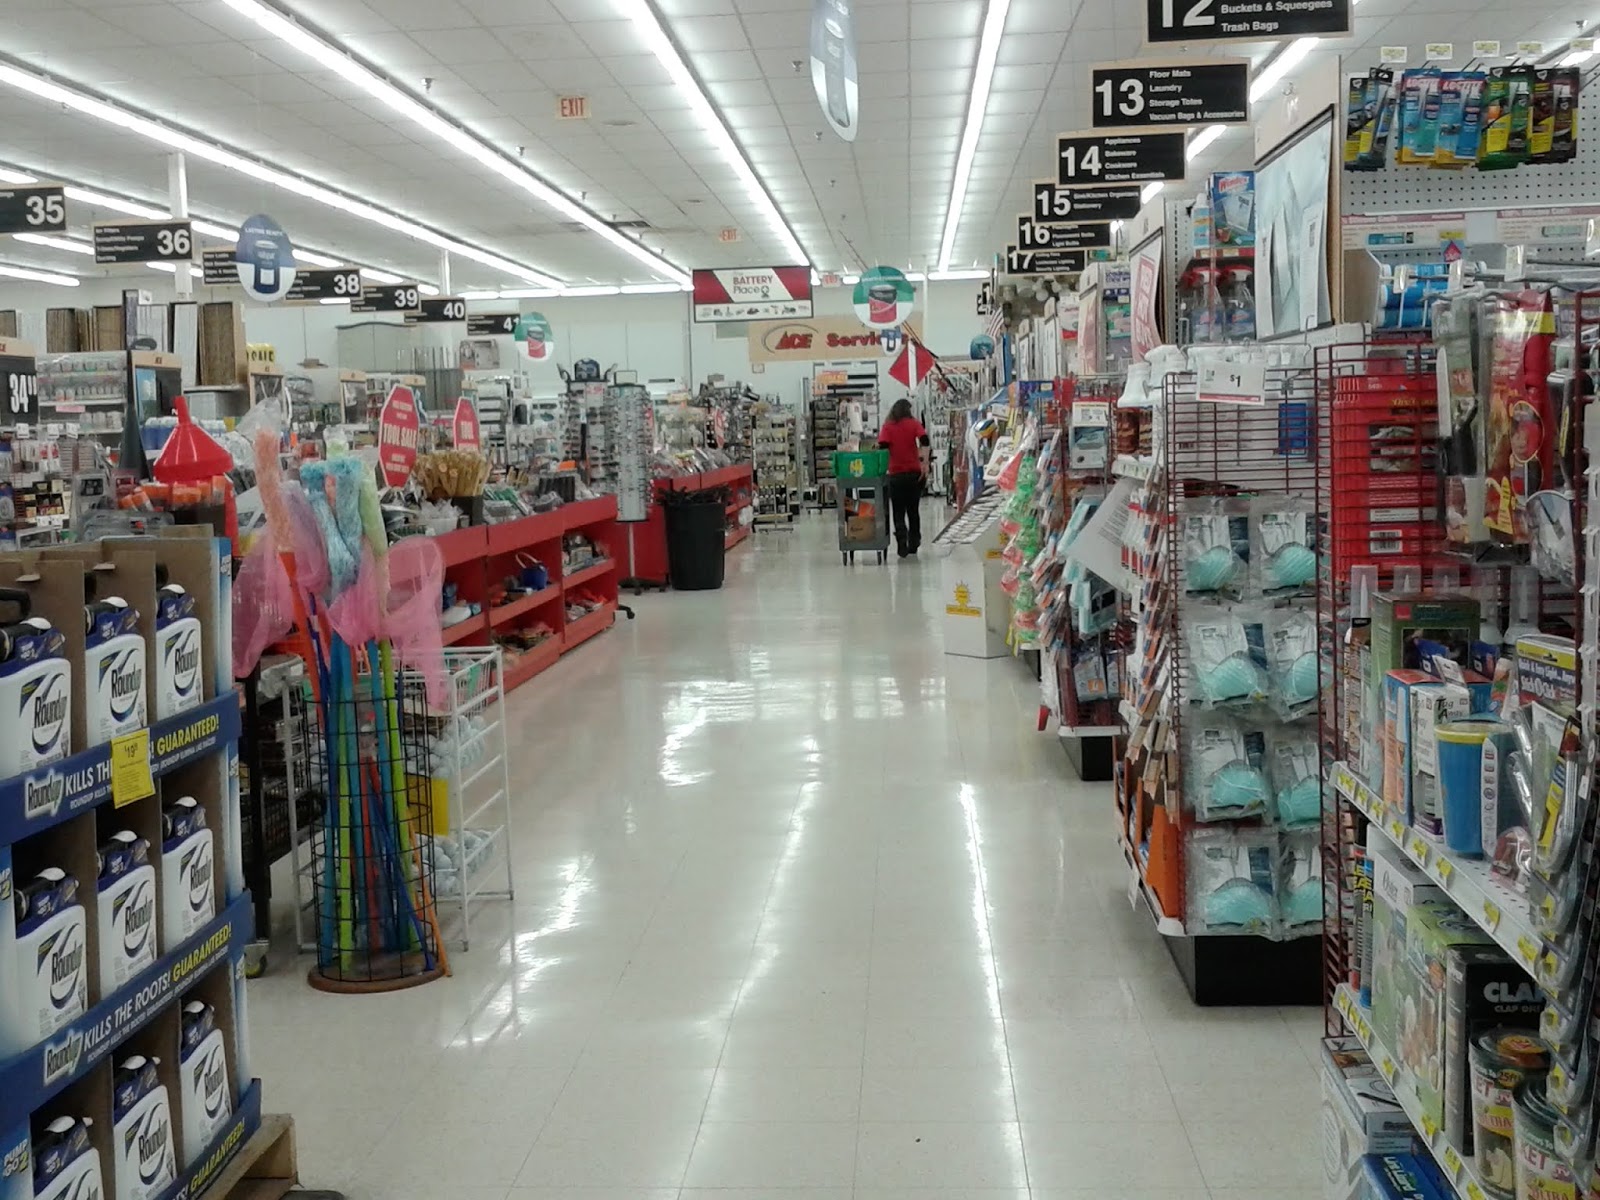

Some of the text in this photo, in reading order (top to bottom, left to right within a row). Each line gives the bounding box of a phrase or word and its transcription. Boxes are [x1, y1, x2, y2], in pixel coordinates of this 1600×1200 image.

[1161, 0, 1216, 28] 12
[1221, 0, 1333, 14] Buckets & Squeegees
[1221, 21, 1279, 32] Trash Bags
[1149, 69, 1192, 79] Floor Mats
[1149, 84, 1182, 93] Laundry
[1442, 80, 1484, 91] LOCTITE
[560, 97, 585, 117] EXIT
[1095, 78, 1145, 117] 13
[1149, 97, 1203, 108] Storage Totes
[1149, 112, 1176, 121] Vacuum
[1177, 111, 1195, 121] Bags
[1203, 110, 1245, 119] Accessories
[1061, 145, 1102, 177] 14
[26, 195, 64, 225] 35
[1037, 189, 1072, 216] 15
[157, 228, 191, 256] 36
[1020, 221, 1050, 245] 16
[1008, 251, 1035, 271] 17
[333, 273, 360, 295] 38
[733, 275, 773, 285] BATTERY
[394, 289, 418, 308] 39
[733, 285, 760, 295] Place
[443, 302, 465, 319] 40
[775, 331, 813, 350] ACE
[1229, 374, 1241, 387] $1
[156, 713, 220, 756] GUARANTEED!
[65, 766, 94, 797] KILLS
[97, 757, 114, 787] TH
[84, 1015, 112, 1052] KILLS
[114, 998, 134, 1029] THE
[135, 971, 171, 1012] ROOTS!
[172, 921, 232, 982] GUARANTEED!
[1494, 1004, 1519, 1013] CLAP
[190, 1116, 245, 1193] GUARANTEED!
